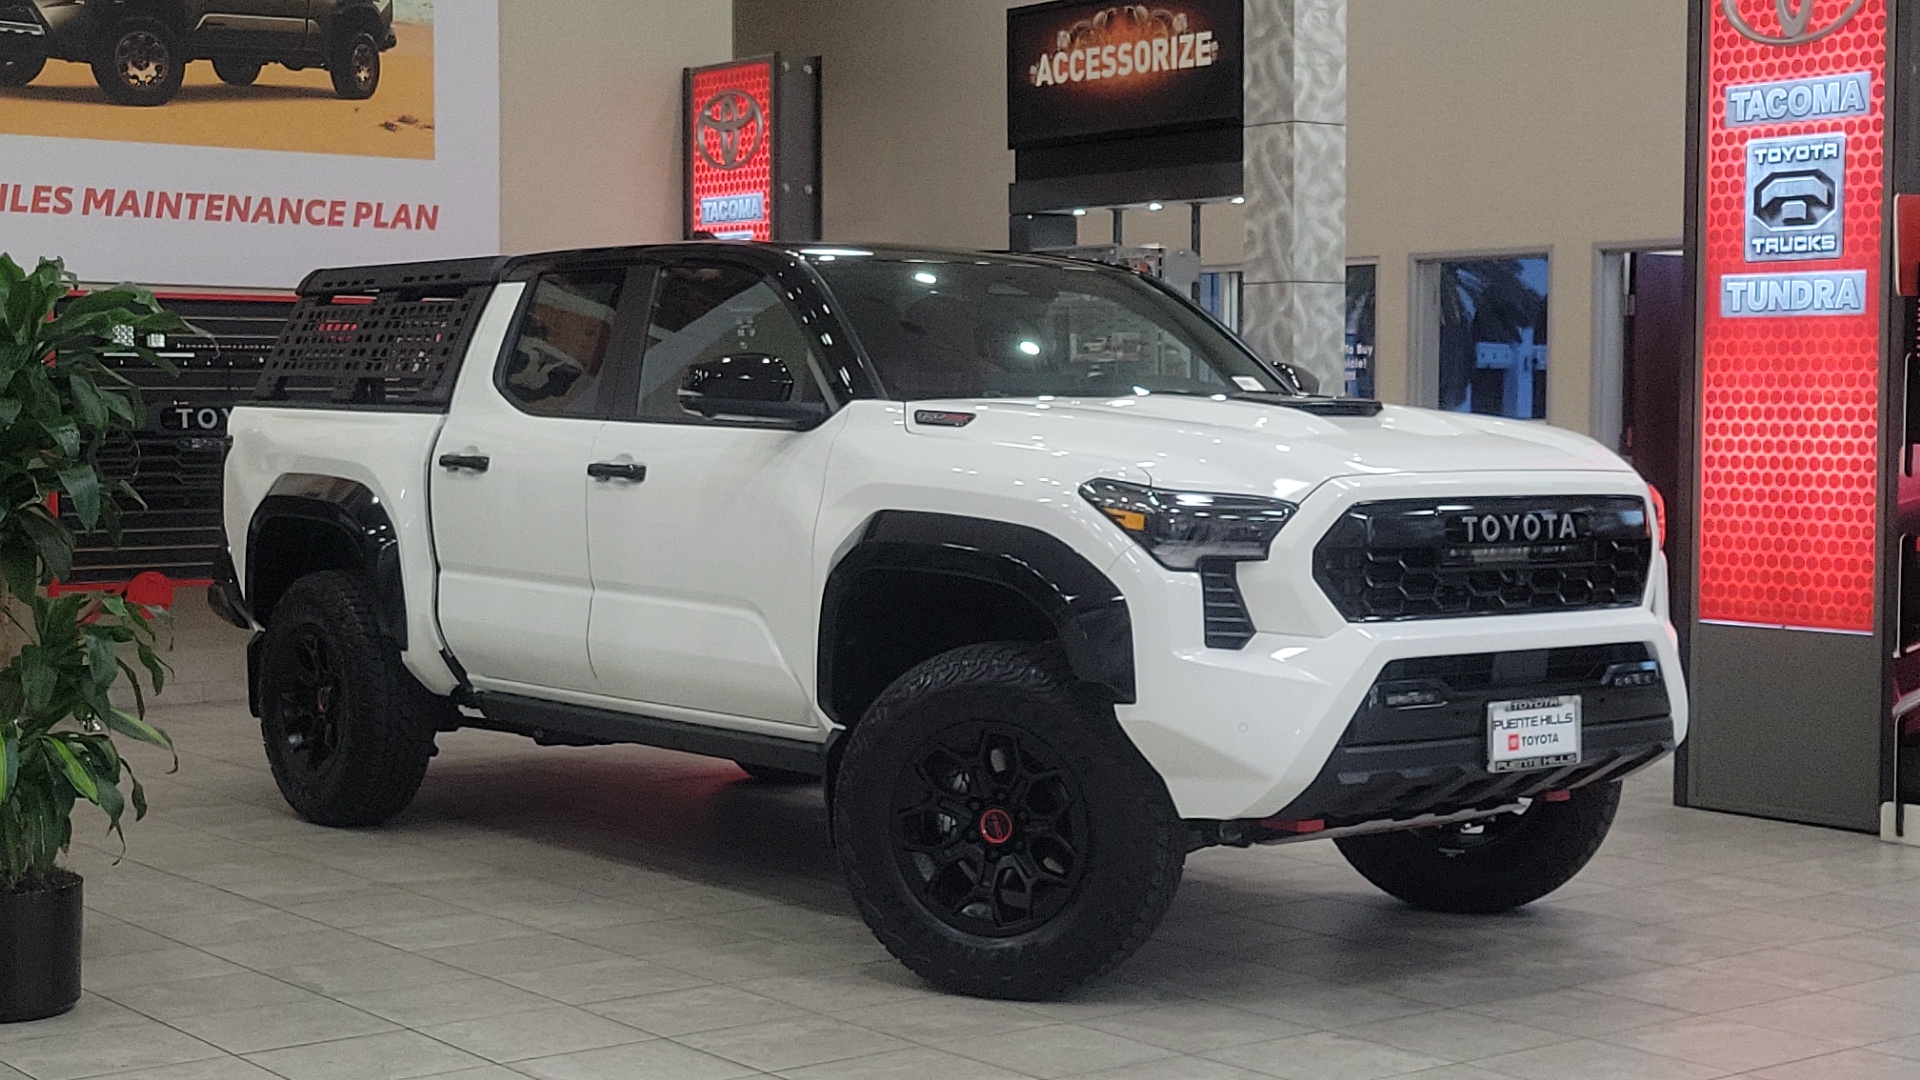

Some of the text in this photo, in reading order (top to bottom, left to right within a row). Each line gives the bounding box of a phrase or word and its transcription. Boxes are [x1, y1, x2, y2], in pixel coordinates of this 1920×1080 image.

[1035, 30, 1213, 88] ACCESSORIZE
[1731, 80, 1866, 122] TACOMA
[1754, 142, 1839, 164] TOYOTA
[81, 187, 347, 228] MAINTENANCE
[353, 201, 440, 231] PLAN
[702, 197, 762, 223] TACOMA
[1752, 234, 1836, 254] TRUCKS
[1726, 278, 1861, 312] TUNDRA
[1462, 513, 1577, 543] TOYOTA
[1512, 700, 1558, 711] TOYOTA
[1494, 713, 1573, 731] PUENTE HILLS
[1522, 733, 1559, 747] TOYOTA
